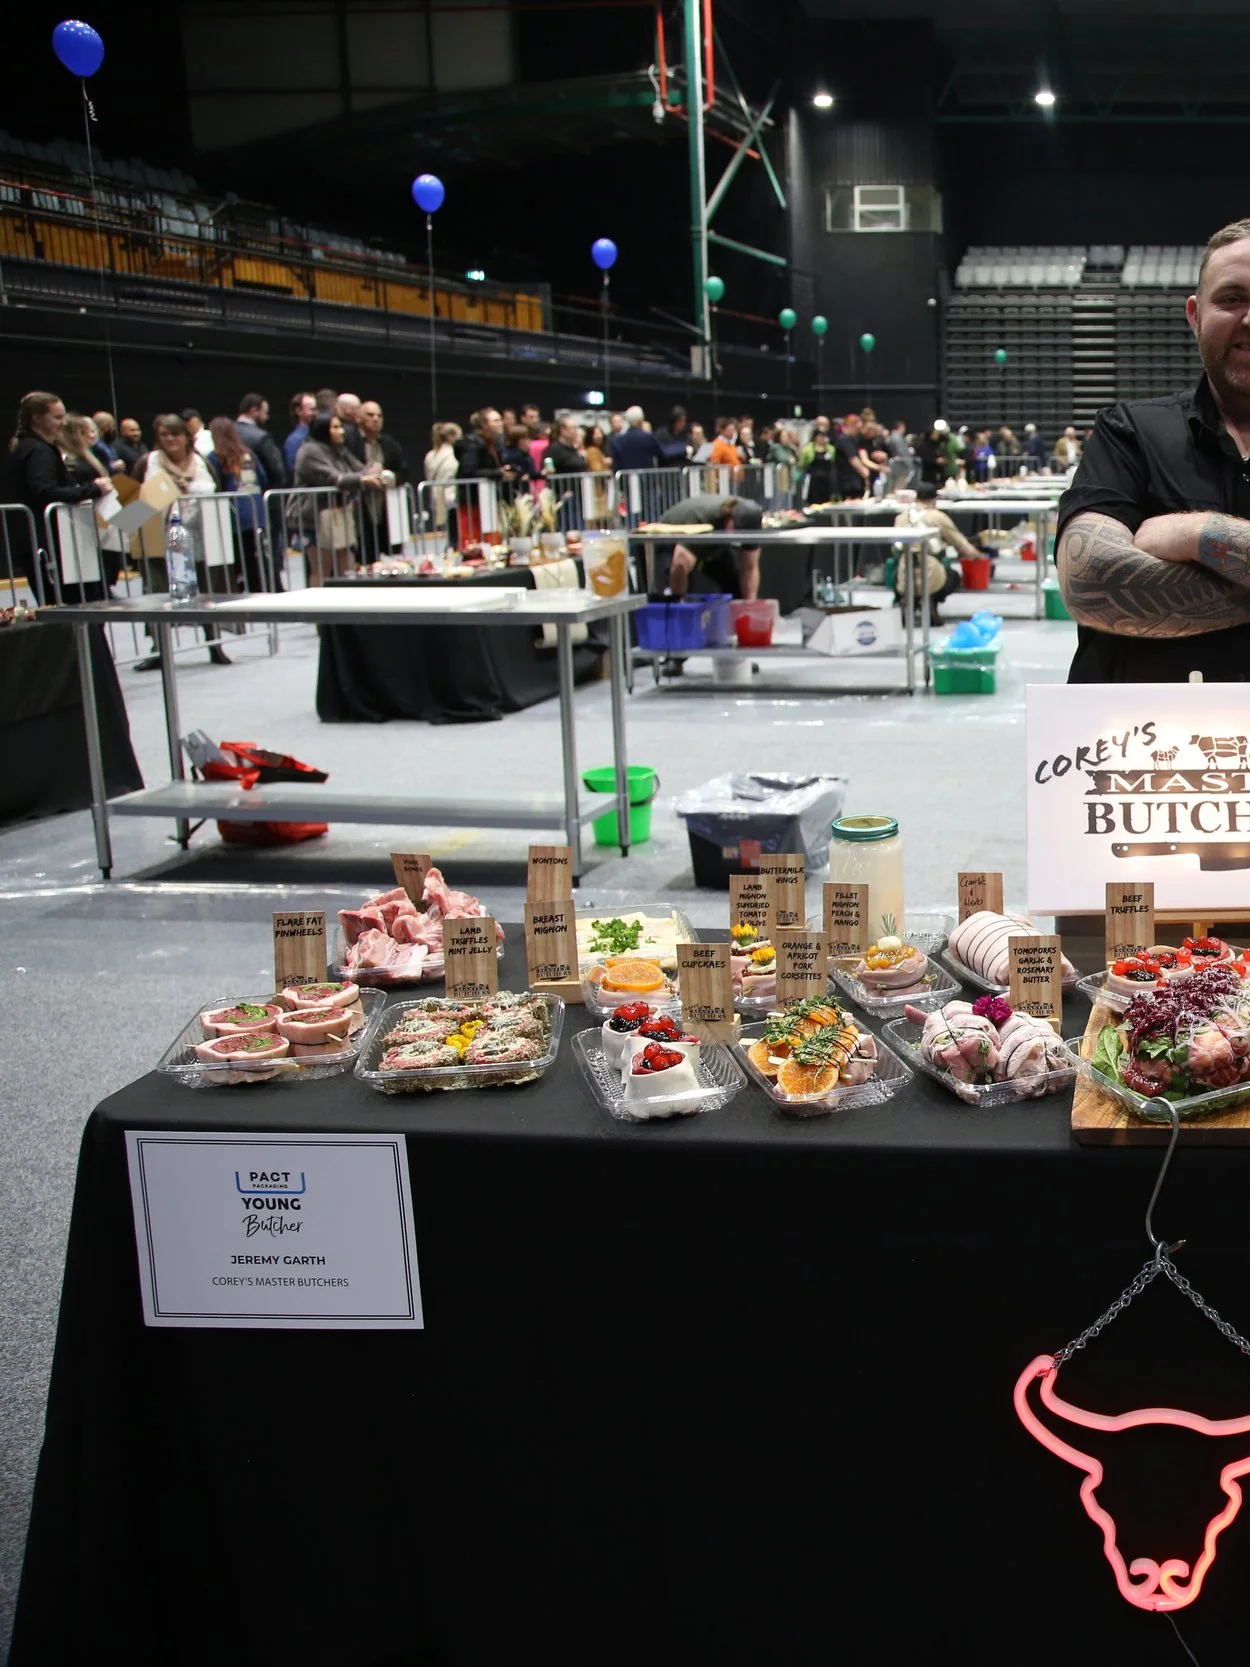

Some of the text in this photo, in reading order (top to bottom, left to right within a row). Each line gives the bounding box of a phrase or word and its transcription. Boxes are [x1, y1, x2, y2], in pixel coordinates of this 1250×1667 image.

[1035, 721, 1157, 785] COREY'S
[532, 857, 568, 865] WONTONS
[760, 866, 805, 875] BUTTERMILK
[1122, 894, 1143, 903] BEEF
[739, 910, 767, 918] TOMATO
[832, 910, 860, 918] PEACH &
[1110, 905, 1149, 915] TRUFFLES
[276, 916, 322, 928] FLARE FAT
[533, 914, 564, 924] BREAST
[275, 928, 323, 938] PINWHEELS
[460, 927, 481, 935] LAMB
[534, 924, 568, 935] MIGNON
[451, 936, 488, 945] TRUFFLES
[782, 942, 814, 950] ORANGE
[815, 942, 821, 950] &
[448, 946, 493, 956] MINT JELLY
[693, 949, 716, 957] BEEF
[1013, 946, 1057, 956] TOMOPORKS
[787, 952, 819, 960] APRICOT
[682, 960, 726, 969] CUPCKAES
[793, 962, 813, 970] PORK
[1017, 966, 1055, 975] ROSEMARY
[781, 972, 822, 980] CORSETTES
[249, 1171, 290, 1182] PACT
[241, 1197, 302, 1211] YOUNG
[242, 1213, 304, 1238] Butcher
[230, 1255, 326, 1266] JEREMY GARTH
[212, 1276, 349, 1287] COREY'S MASTER BUTCHERS
